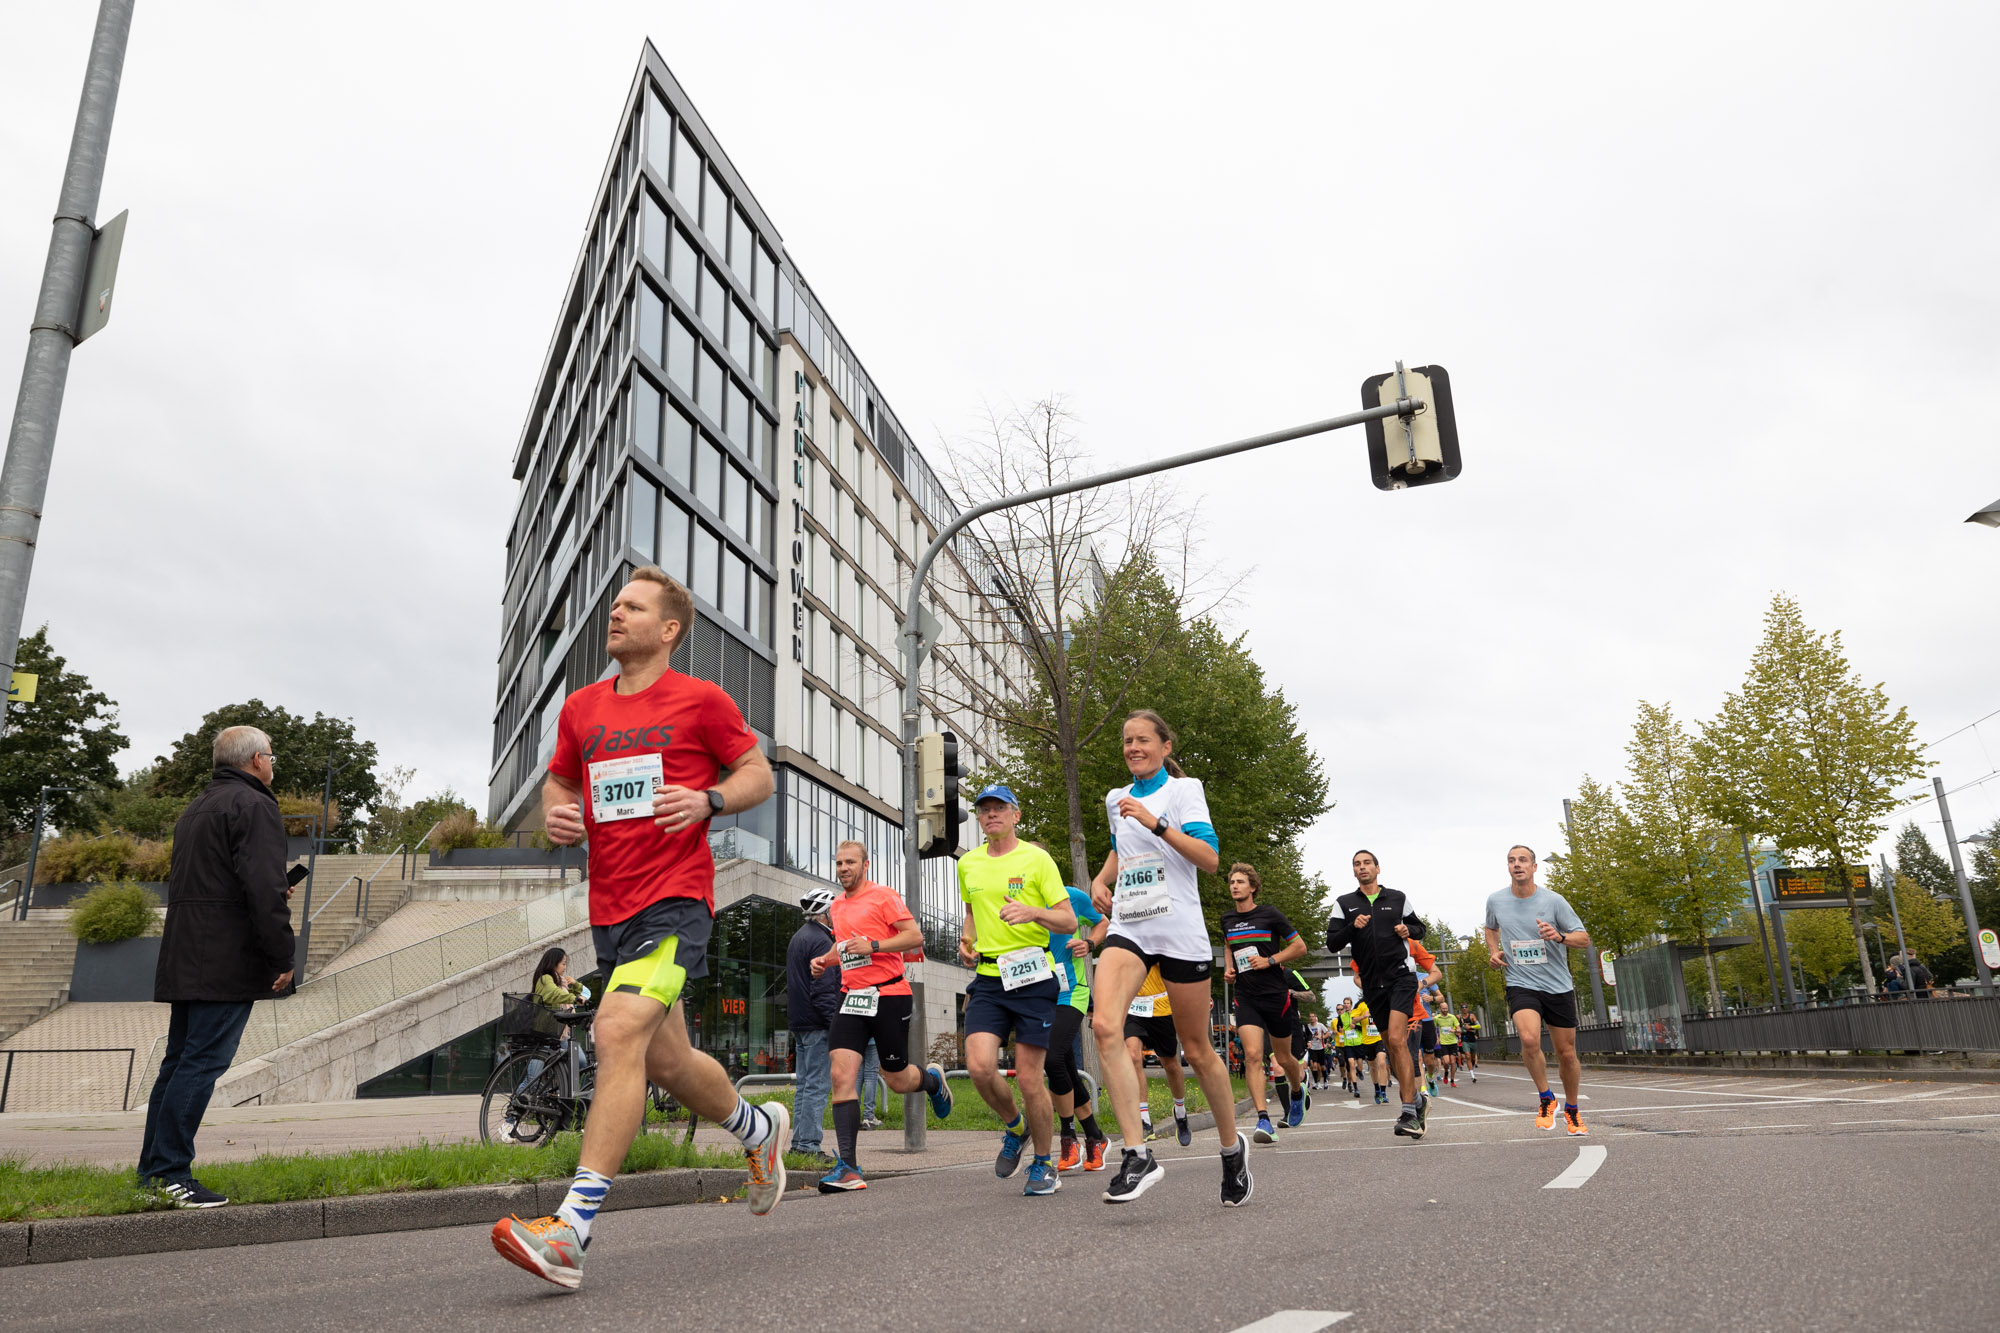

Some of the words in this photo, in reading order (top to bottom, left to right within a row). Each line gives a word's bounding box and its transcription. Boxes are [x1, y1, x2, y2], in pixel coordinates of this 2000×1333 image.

[794, 370, 804, 488] PARK
[791, 498, 804, 663] TOWER
[604, 780, 645, 802] 3707
[616, 807, 635, 816] Marc
[1125, 870, 1153, 887] 2166
[1119, 905, 1169, 921] Spendenläufer
[1519, 949, 1539, 958] 1314
[1010, 960, 1038, 977] 2251
[1020, 977, 1036, 985] Volker
[721, 998, 746, 1016] VIER
[848, 997, 869, 1007] 8104
